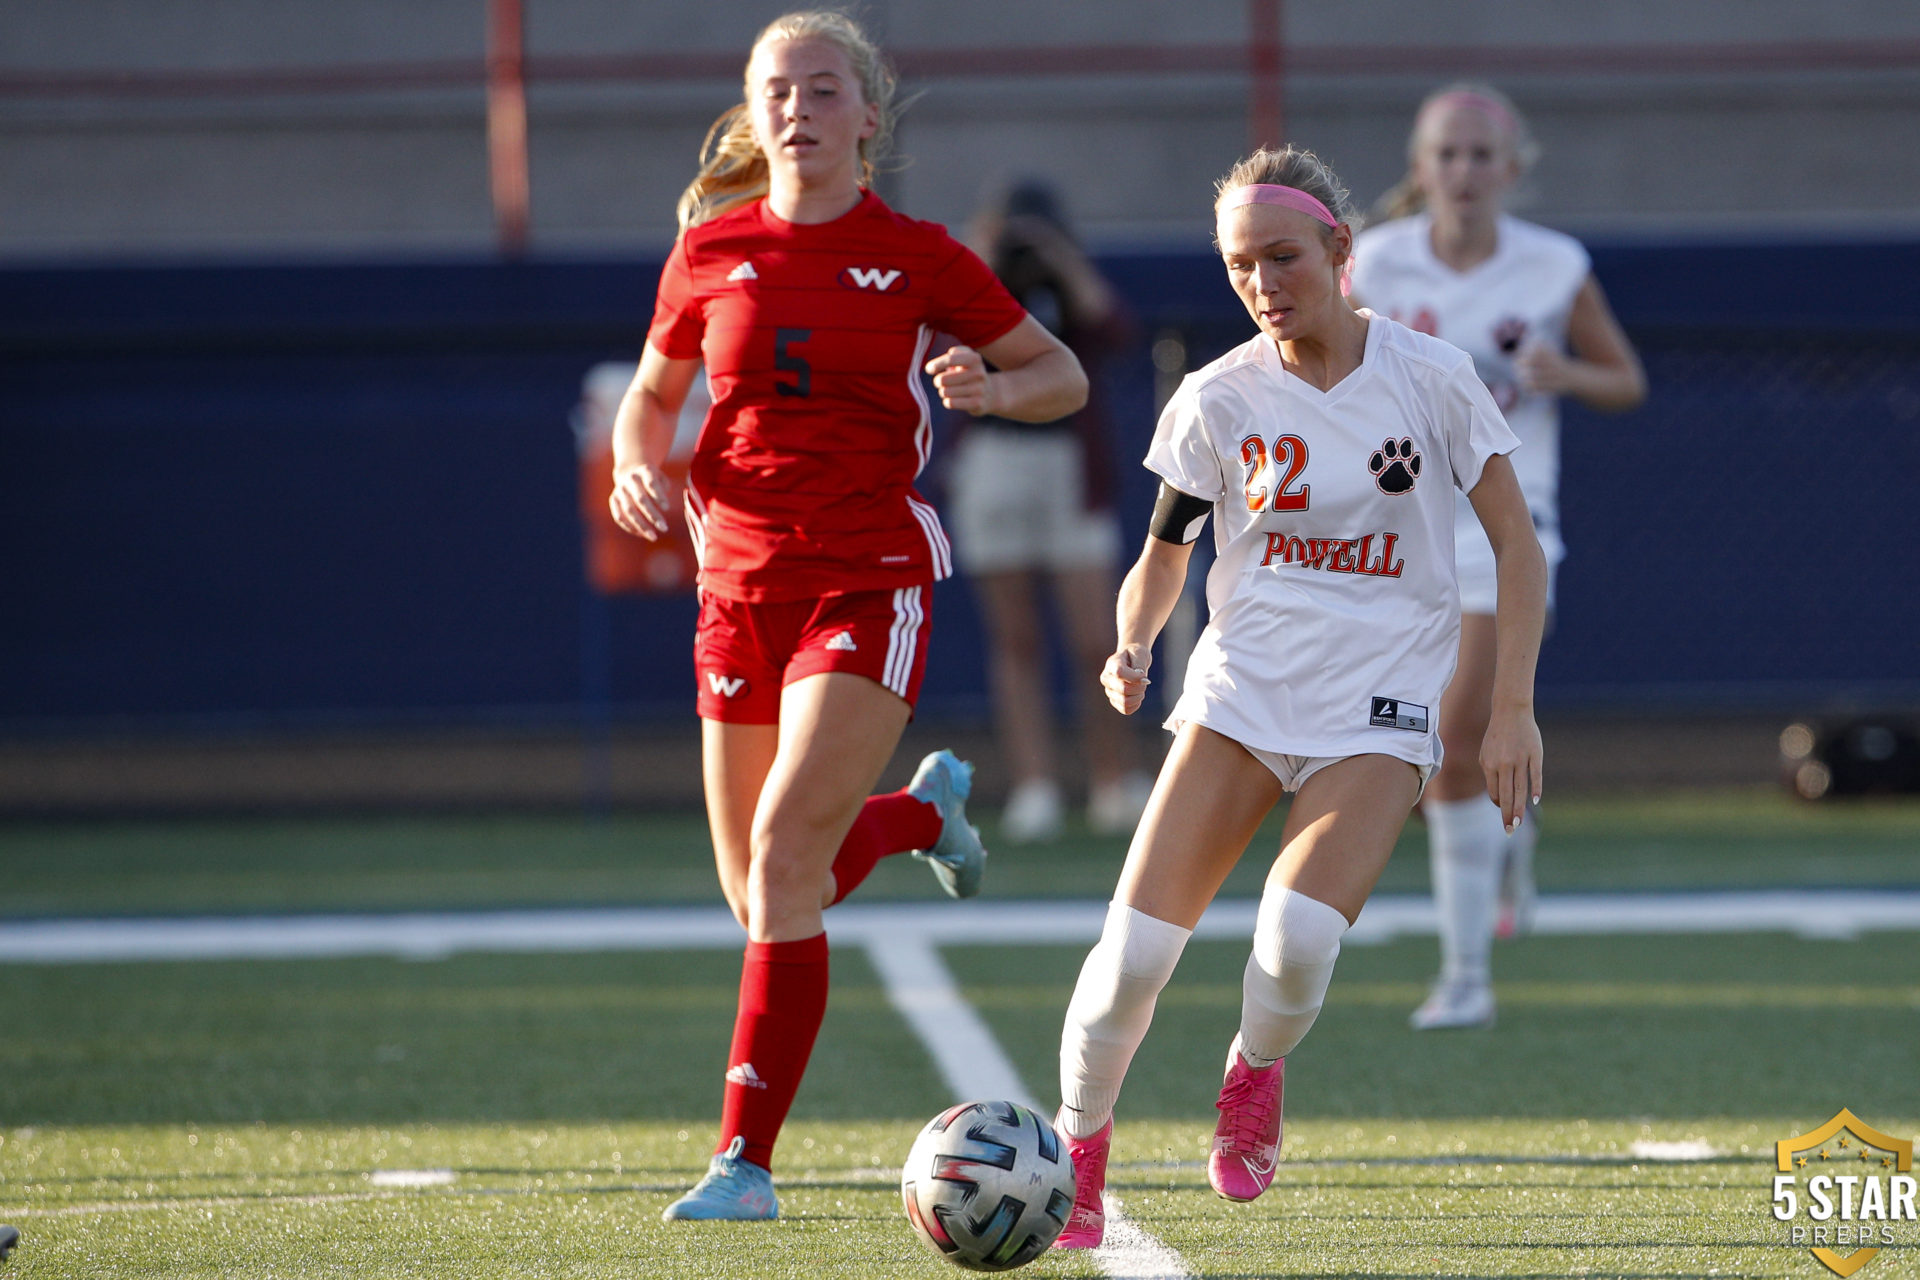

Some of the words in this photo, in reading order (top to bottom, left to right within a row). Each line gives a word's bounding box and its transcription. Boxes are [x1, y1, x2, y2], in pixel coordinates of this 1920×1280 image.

[847, 267, 902, 291] W
[774, 327, 812, 398] 5
[1240, 433, 1310, 513] 22
[1260, 531, 1404, 578] POWELL
[707, 672, 746, 698] W
[1409, 718, 1416, 726] S
